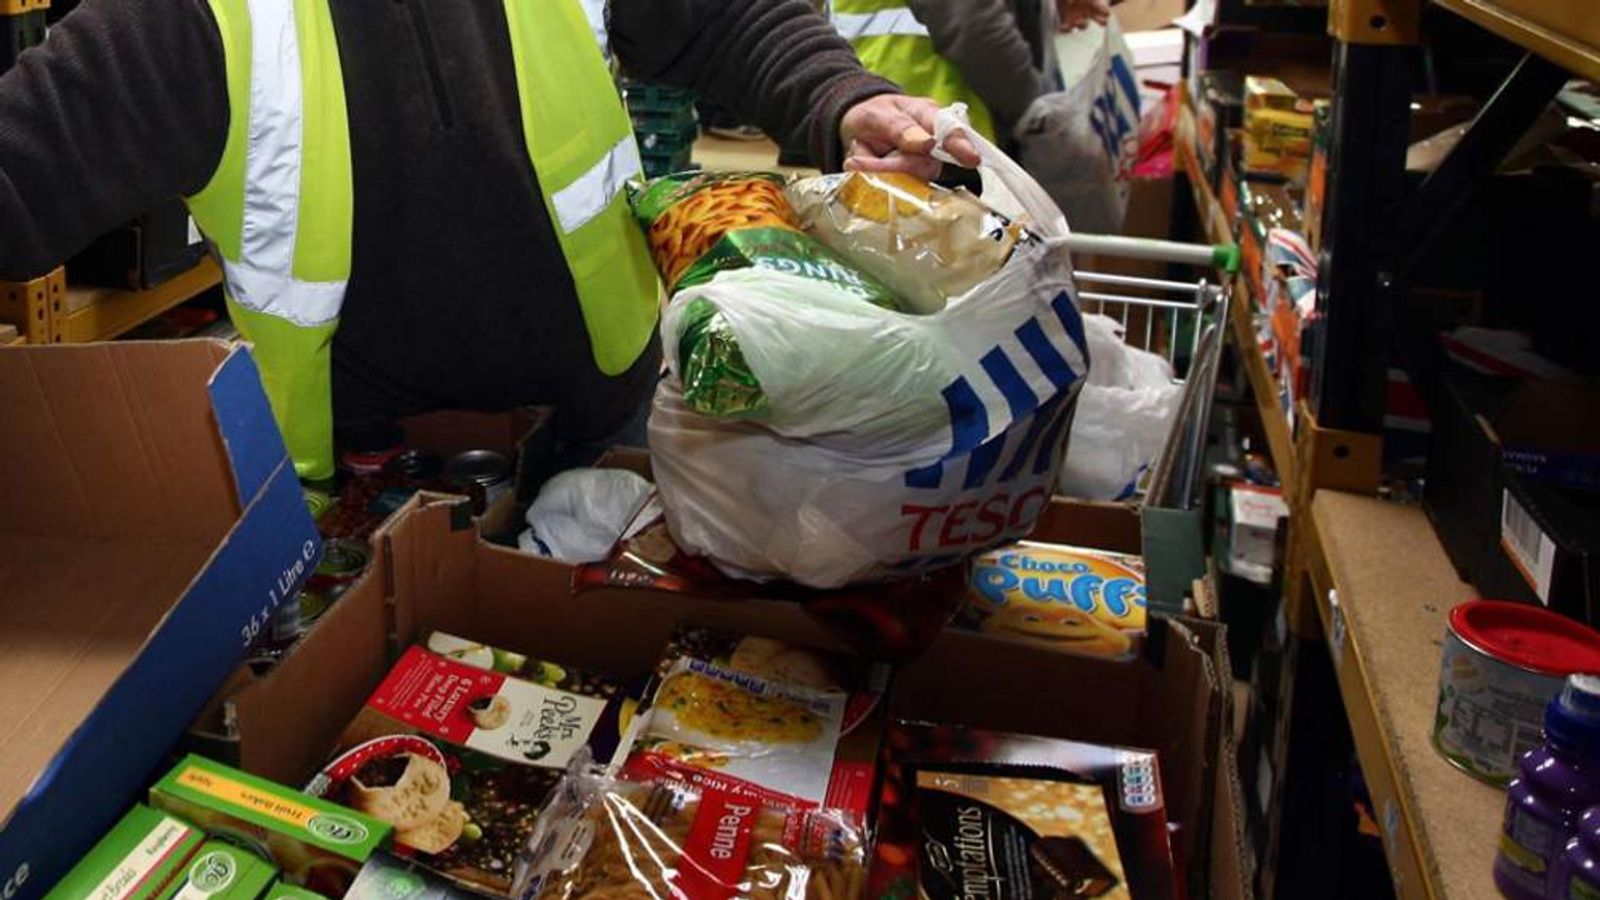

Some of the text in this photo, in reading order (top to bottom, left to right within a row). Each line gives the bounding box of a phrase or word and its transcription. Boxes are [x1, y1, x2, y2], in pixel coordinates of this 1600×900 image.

[1000, 553, 1090, 573] Choco
[242, 614, 259, 646] 36
[278, 560, 304, 596] Litre
[434, 684, 471, 723] Luxury
[709, 802, 753, 860] Penne
